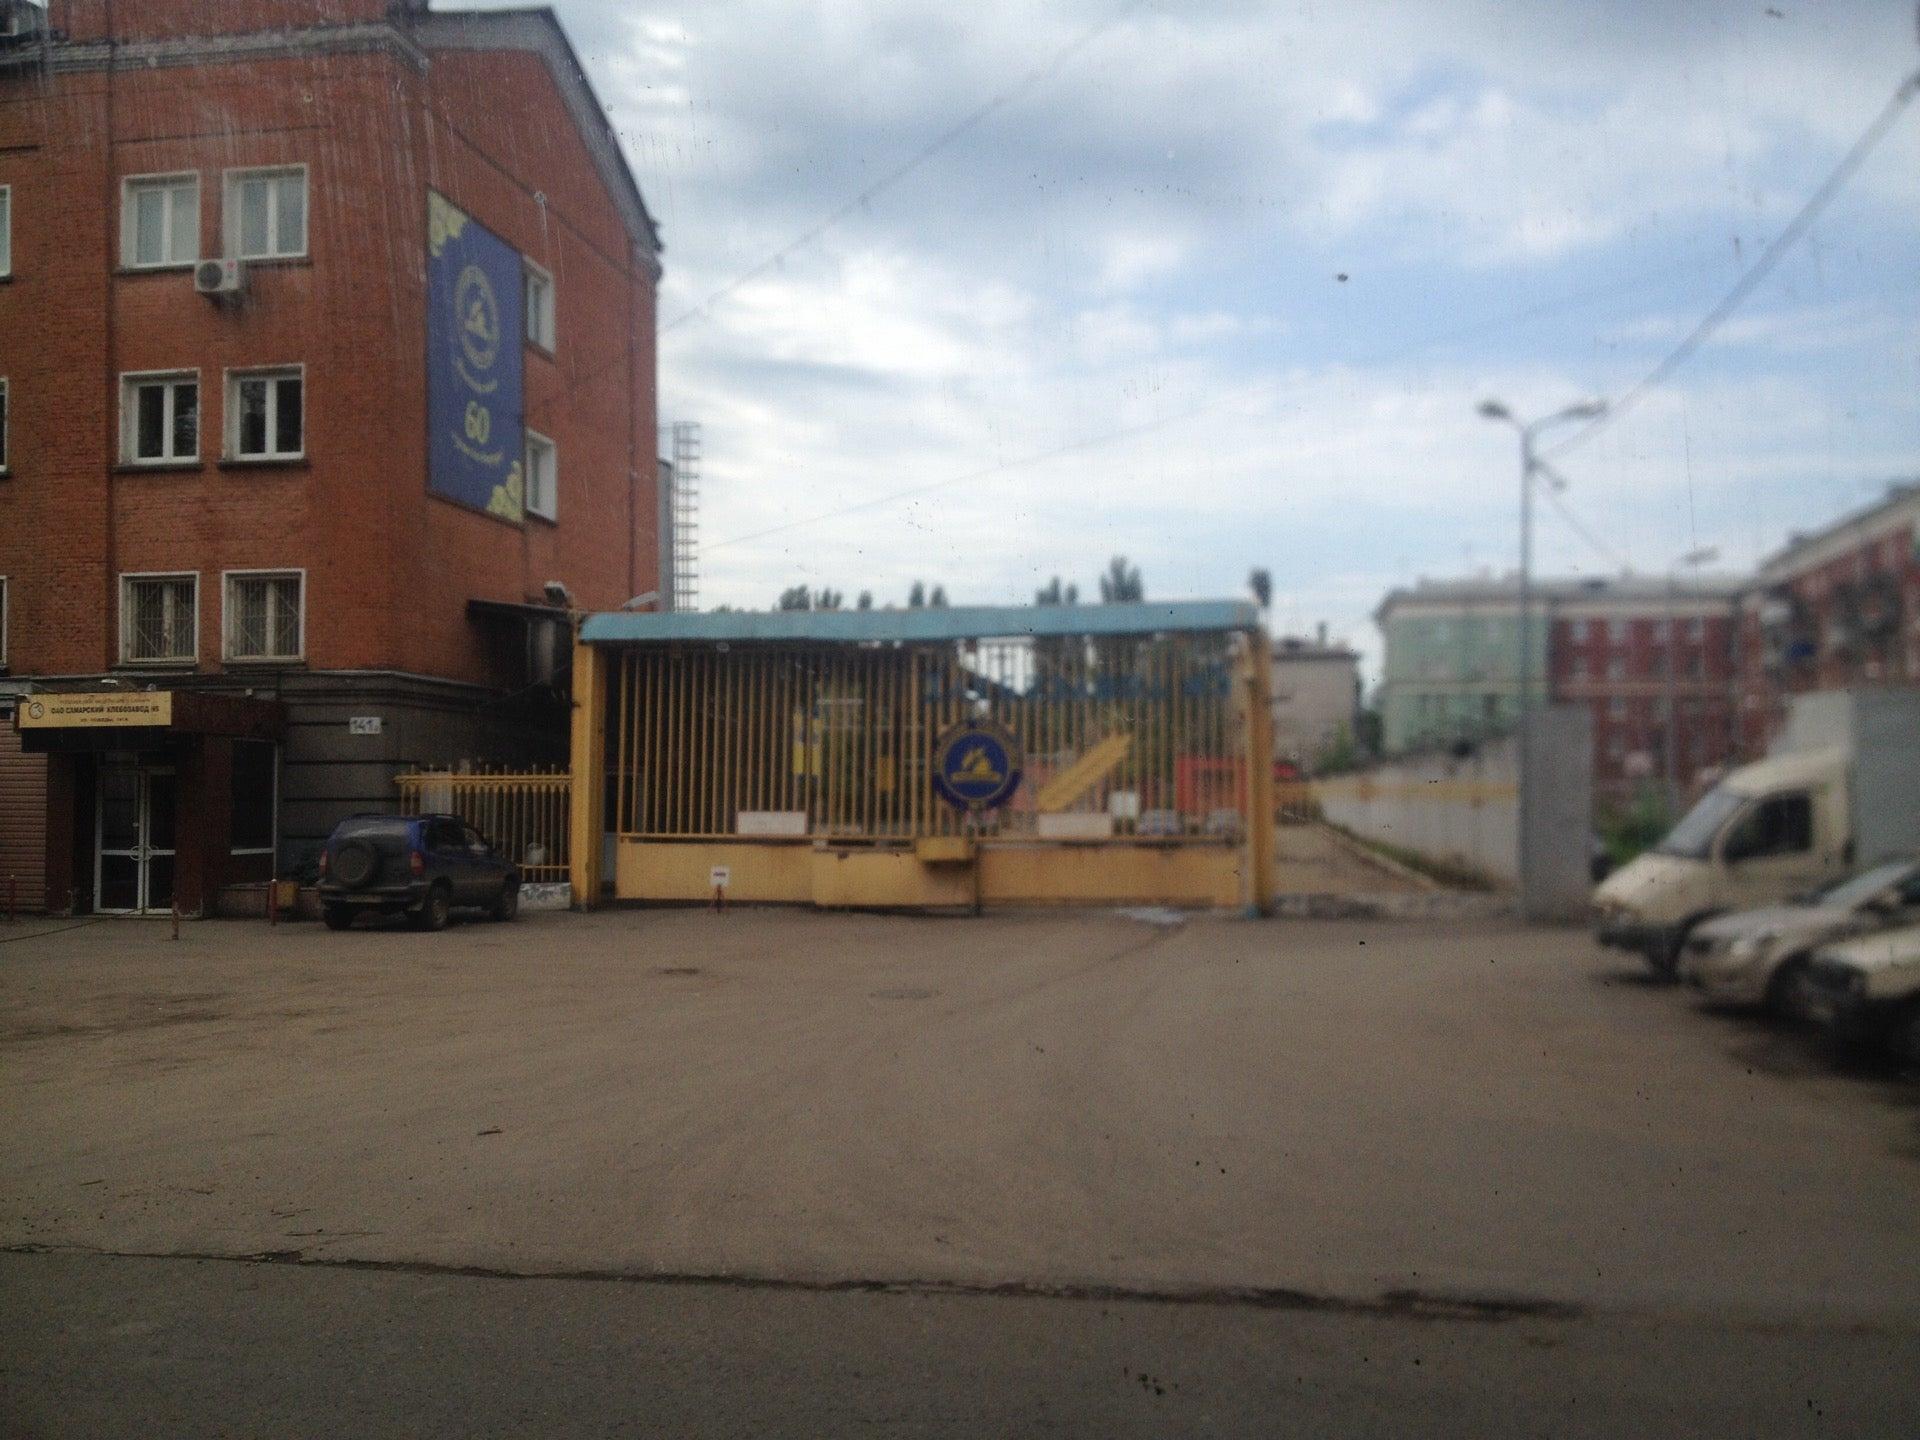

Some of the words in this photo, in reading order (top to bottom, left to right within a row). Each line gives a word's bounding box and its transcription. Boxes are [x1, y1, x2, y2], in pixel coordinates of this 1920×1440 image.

[464, 400, 490, 444] 60
[51, 706, 65, 714] ОАО
[66, 705, 104, 714] САМАРСКИЙ
[106, 705, 149, 714] ХЛЕБОЗАВОД
